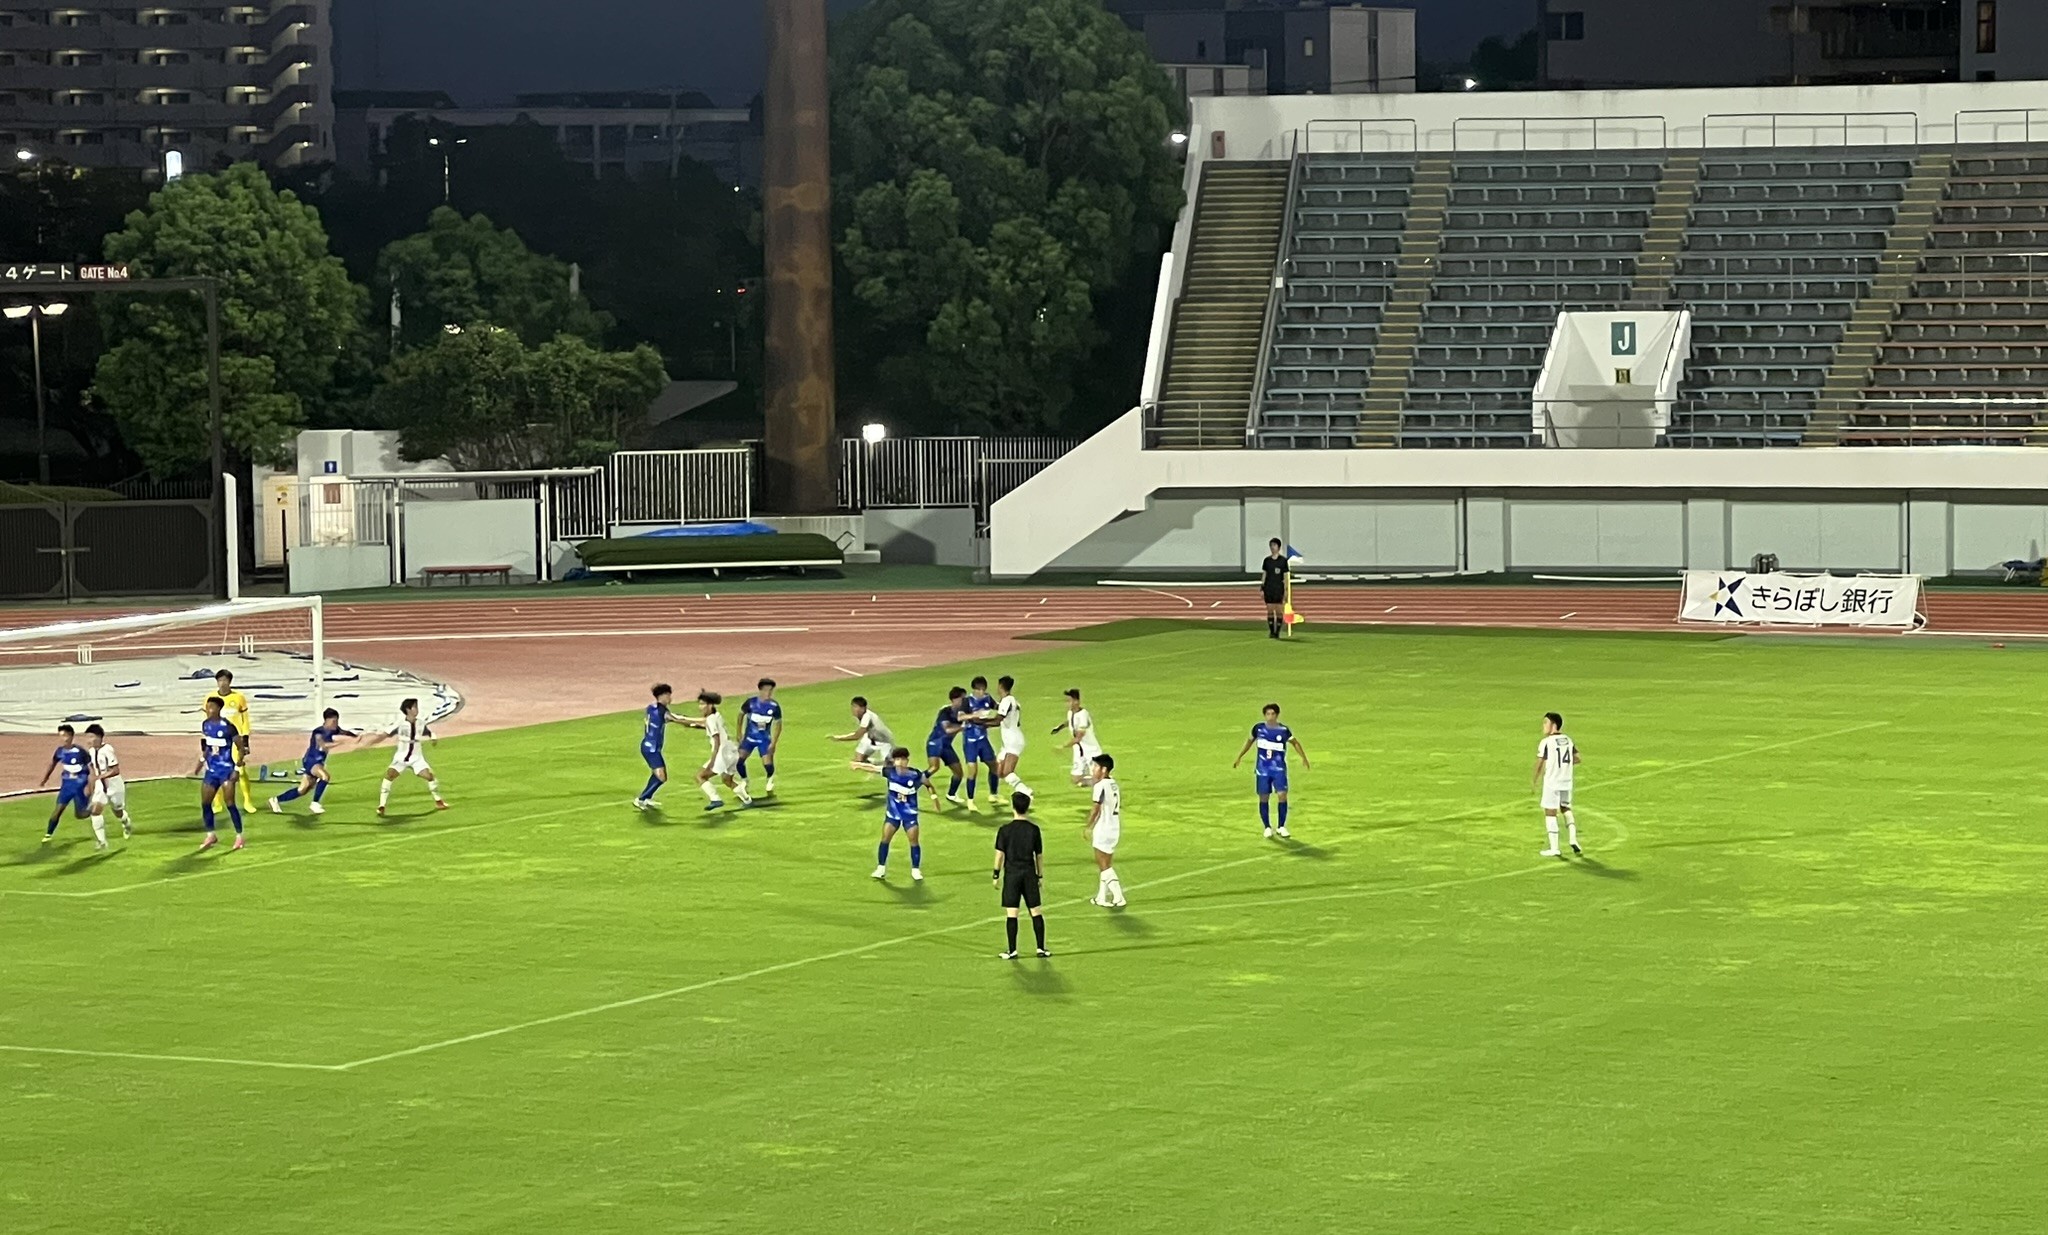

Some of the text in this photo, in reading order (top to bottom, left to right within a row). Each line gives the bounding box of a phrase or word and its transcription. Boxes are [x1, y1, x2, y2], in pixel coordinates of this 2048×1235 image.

[0, 265, 72, 280] 4ゲート
[80, 267, 104, 279] GATE
[1618, 326, 1630, 351] J
[1751, 586, 1894, 614] きらぼし銀行
[1556, 747, 1571, 768] 14
